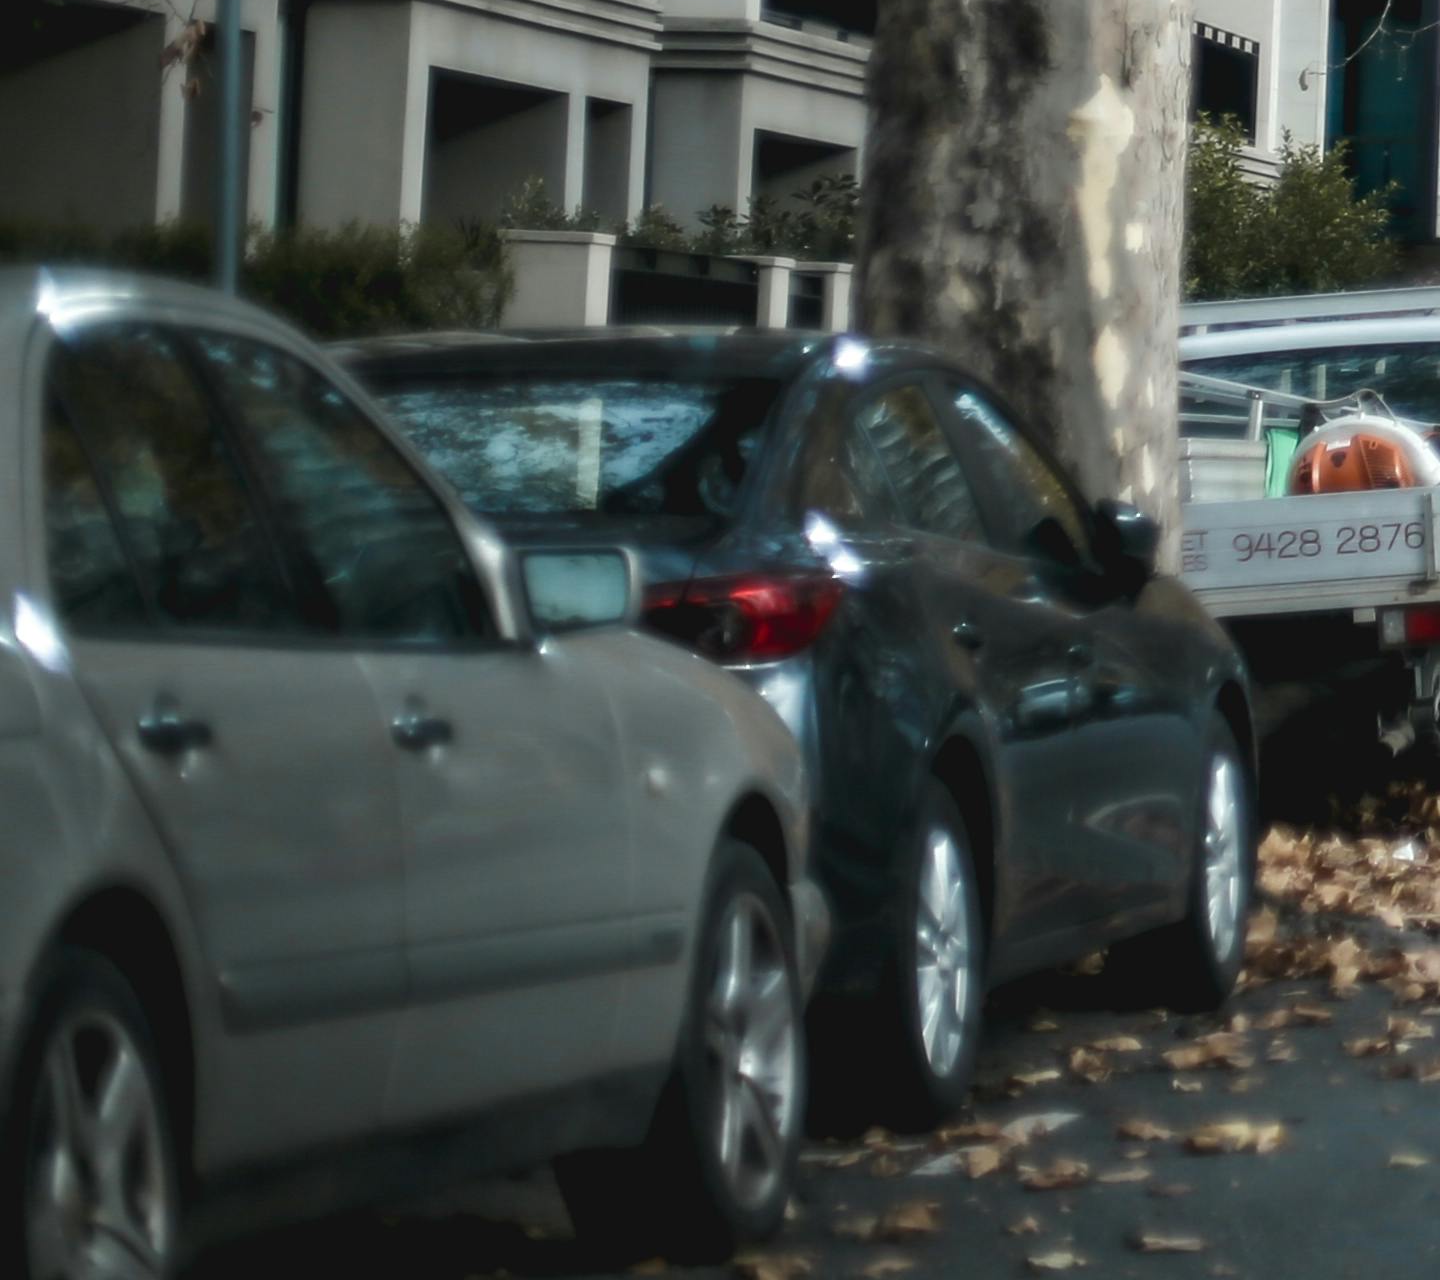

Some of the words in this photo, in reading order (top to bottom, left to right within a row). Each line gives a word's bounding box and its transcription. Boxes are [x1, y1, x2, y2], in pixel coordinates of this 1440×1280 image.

[1183, 529, 1208, 552] ET
[1232, 529, 1322, 562] 9428
[1336, 522, 1426, 554] 2876
